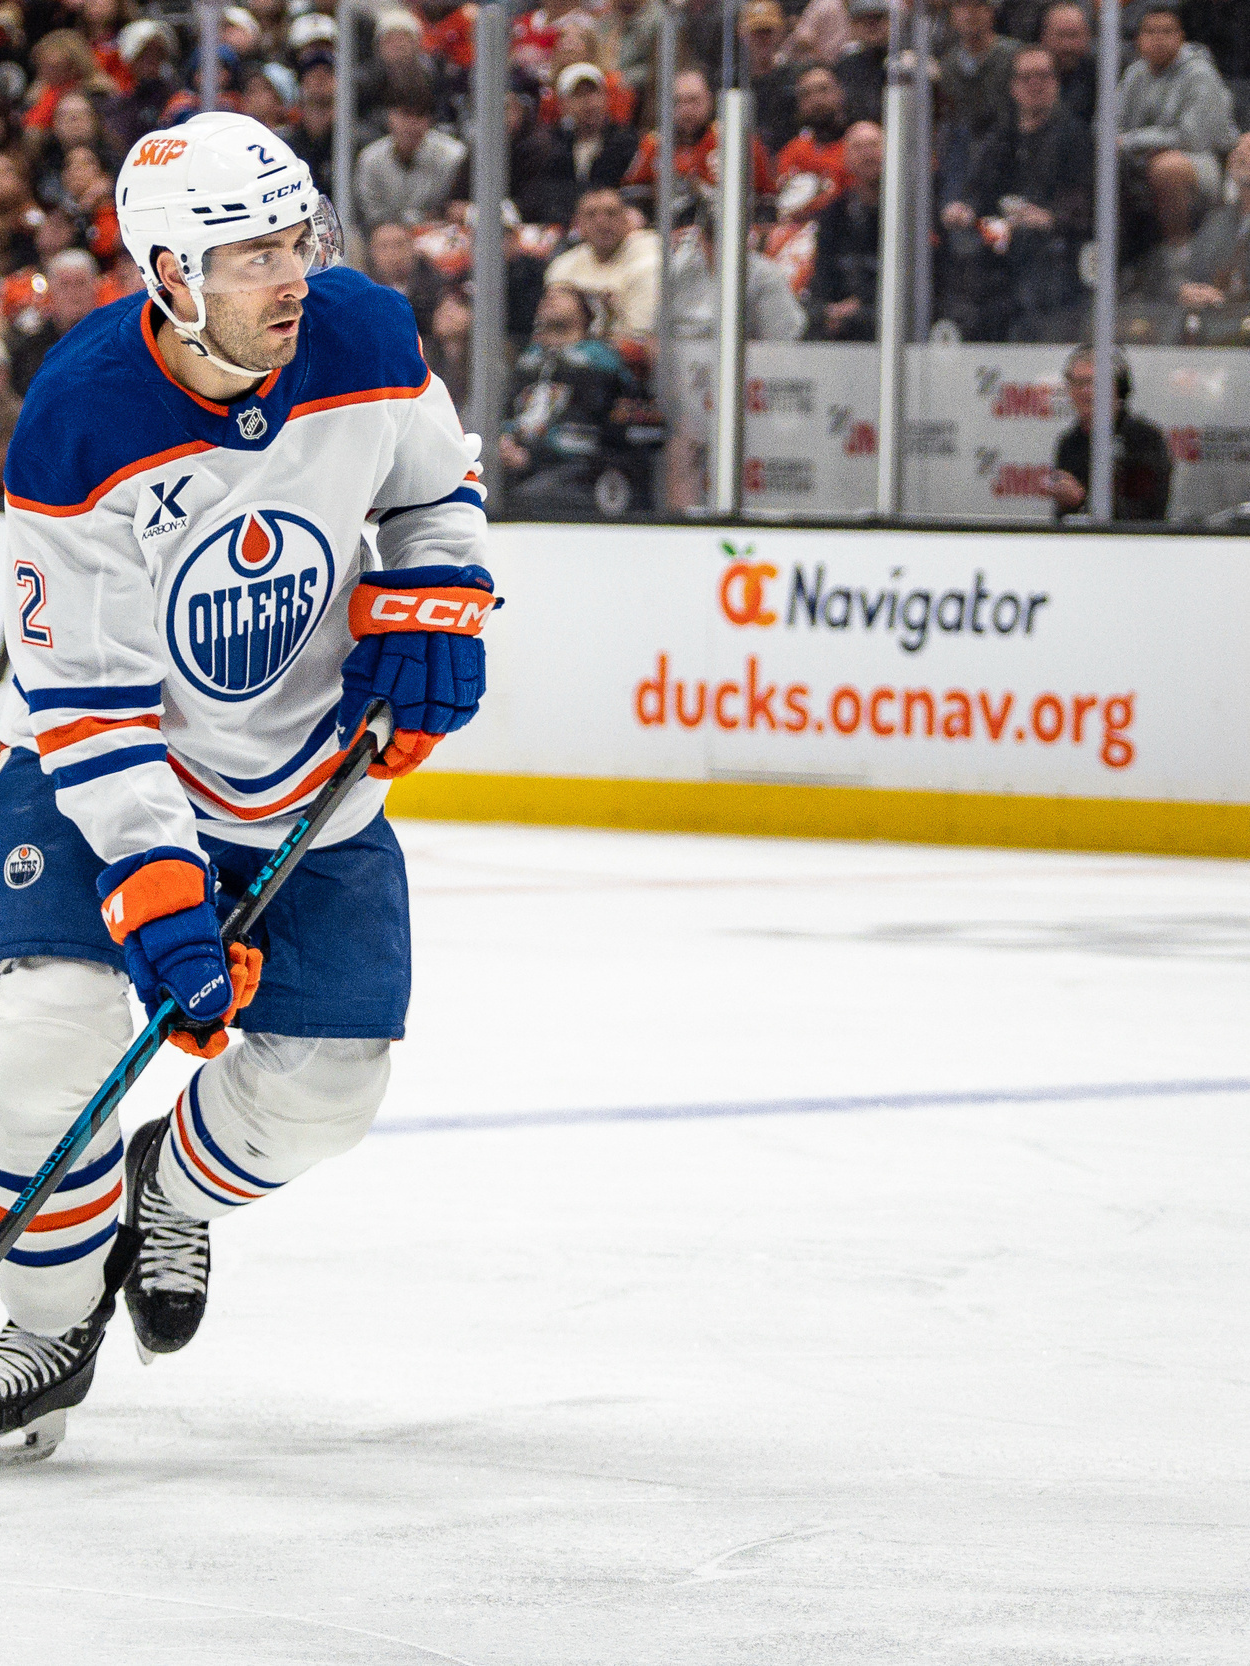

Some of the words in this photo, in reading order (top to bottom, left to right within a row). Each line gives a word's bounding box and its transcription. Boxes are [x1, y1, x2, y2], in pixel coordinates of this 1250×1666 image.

[133, 139, 188, 167] SKIP
[246, 144, 276, 167] 2
[261, 180, 302, 204] CCM
[141, 517, 188, 541] KARBON-X
[13, 559, 54, 649] 2
[370, 593, 496, 628] CCM
[786, 562, 1049, 653] Navigator
[188, 567, 318, 690] OILERS
[634, 650, 1136, 770] ducks.ocnav.org
[248, 817, 310, 897] CCM
[188, 974, 225, 1009] CCM
